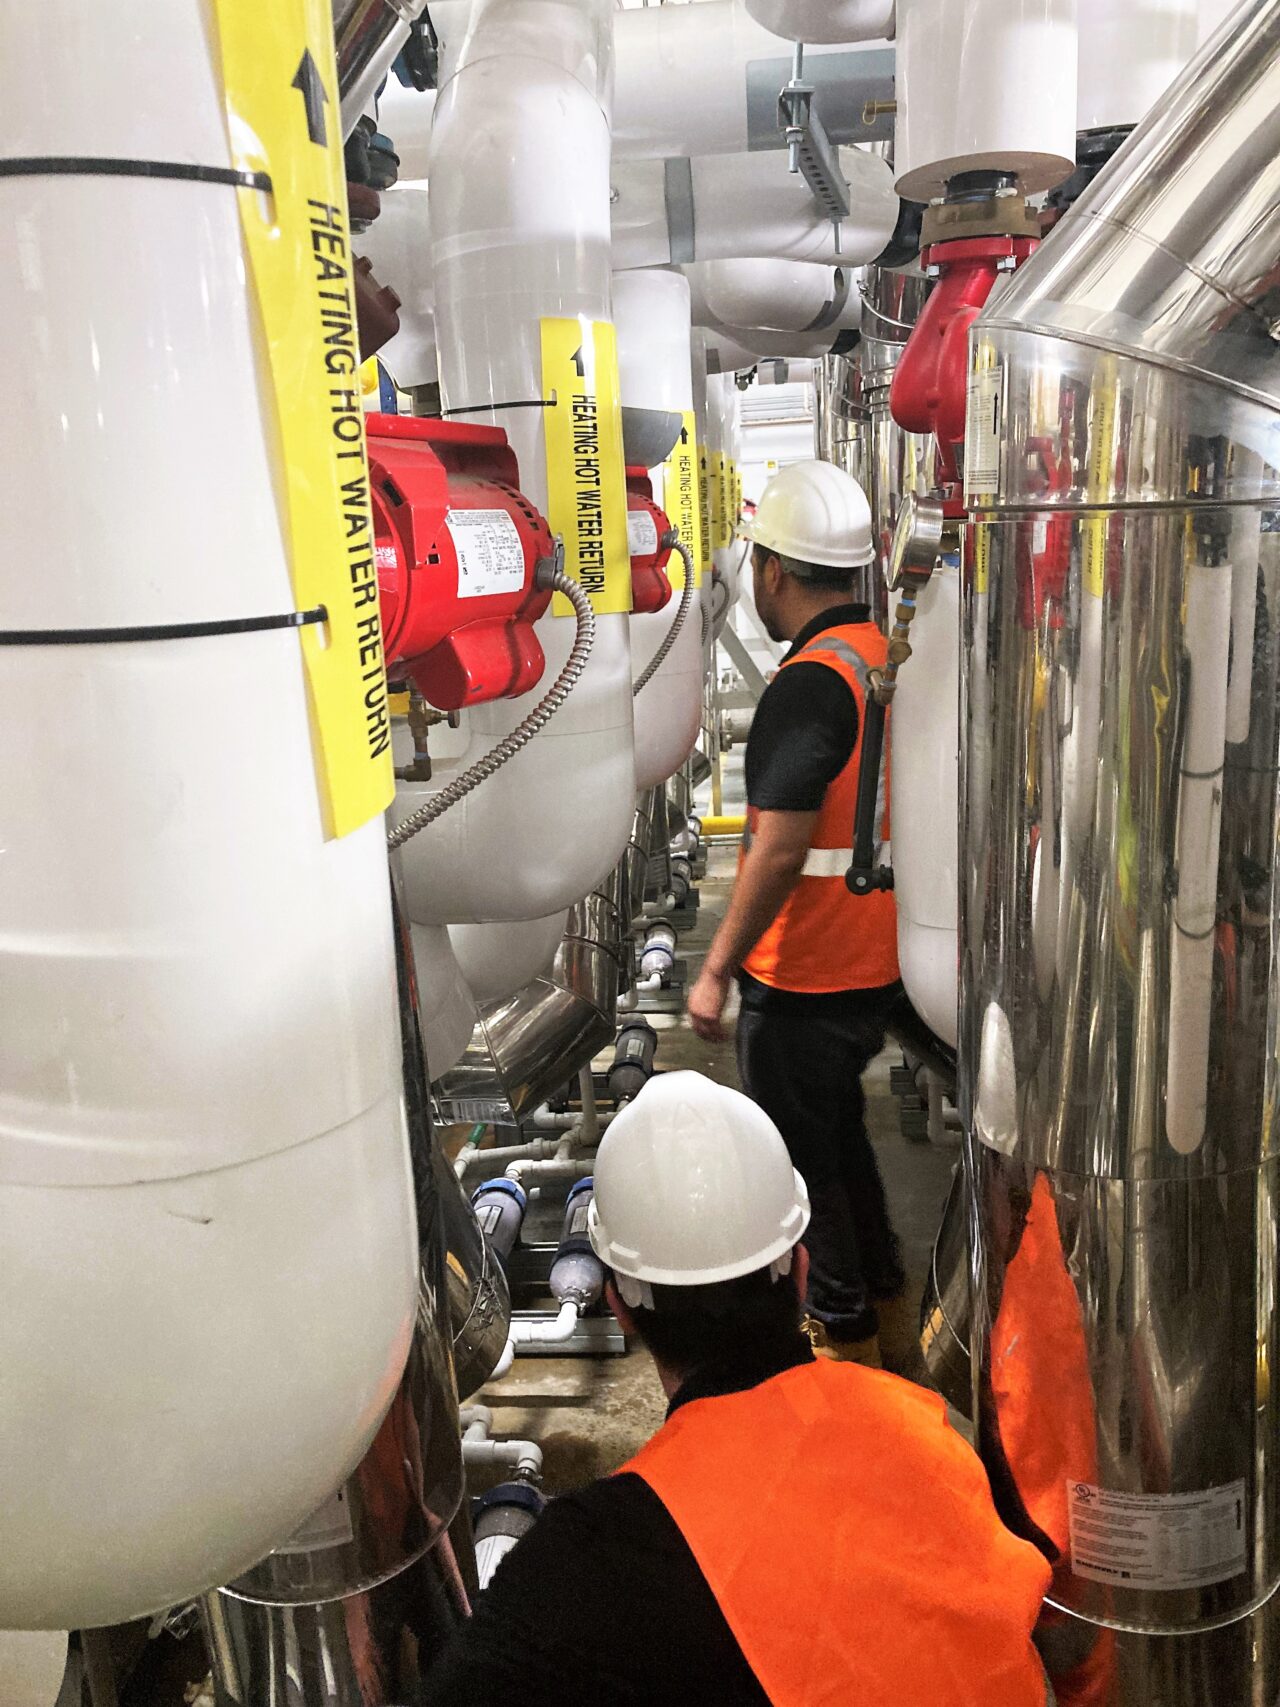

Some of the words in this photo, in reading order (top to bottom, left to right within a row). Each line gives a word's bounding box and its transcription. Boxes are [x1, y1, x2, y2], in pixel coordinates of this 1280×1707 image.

[307, 199, 356, 376] HEATING
[330, 389, 366, 463] HOT
[571, 394, 599, 455] HEATING
[574, 457, 600, 487] HOT
[679, 455, 692, 492] HEATING
[700, 477, 708, 503] HEATING
[576, 489, 602, 538] WATER
[680, 493, 692, 511] HOT
[701, 504, 709, 516] HOT
[340, 476, 378, 610] WATER
[681, 512, 693, 542] WATER
[701, 516, 710, 538] WATER
[578, 540, 606, 594] RETURN
[701, 538, 710, 562] RETURN
[356, 619, 390, 760] RETURN
